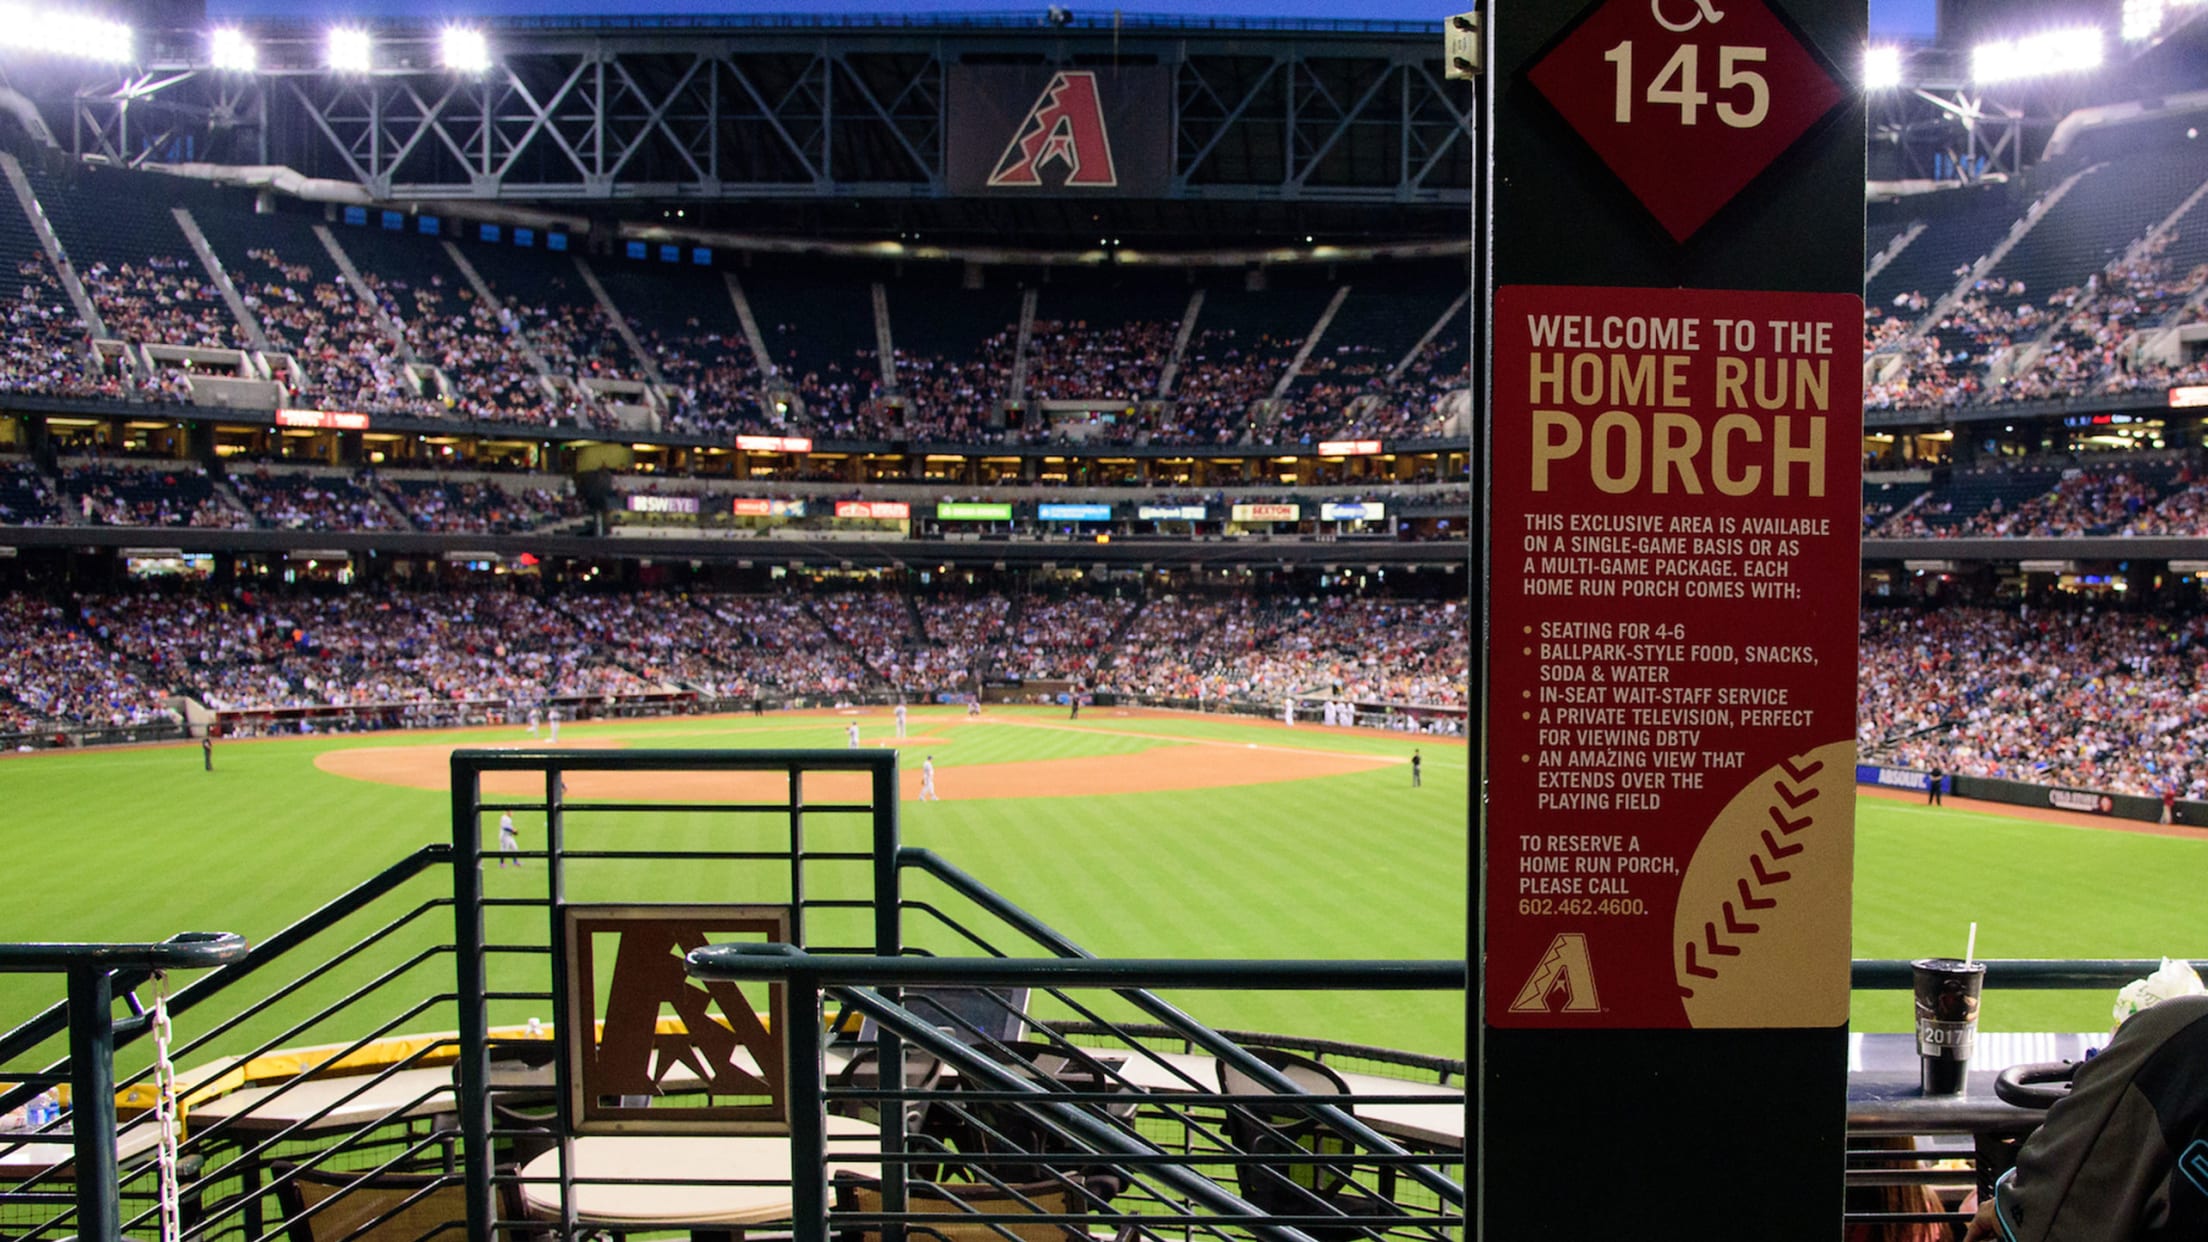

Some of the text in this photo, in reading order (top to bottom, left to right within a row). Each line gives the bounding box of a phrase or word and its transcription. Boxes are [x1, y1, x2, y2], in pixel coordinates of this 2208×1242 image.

[1604, 40, 1770, 128] 145
[1528, 314, 1833, 353] WELCOME TO THE
[1530, 352, 1830, 410] HOME RUN
[1531, 409, 1826, 497] PORCH
[1524, 514, 1830, 535] THIS EXCLUSIVE AREA IS AVAILABLE
[1524, 536, 1800, 556] ON A SINGLE-GAME BASIS OR AS
[1524, 558, 1788, 577] A MULTI-GAME PACKAGE. EACH
[1524, 579, 1801, 599] HOME RUN PORCH COMES WITH:
[1540, 622, 1685, 640] SEATING FOR 4-6
[1540, 644, 1818, 665] BALLPARK-STYLE FOOD, SNACKS,
[1540, 666, 1669, 682] SODA & WATER
[1540, 687, 1788, 705] IN-SEAT WAIT-STAFF SERVICE
[1539, 709, 1813, 728] A PRIVATE TELEVISION, PERFECT
[1539, 730, 1700, 746] FOR VIEWING DBTV
[1538, 751, 1745, 768] AN AMAZING VIEW THAT
[1538, 772, 1703, 789] EXTENDS OVER THE
[1538, 793, 1660, 810] PLAYING FIELD
[1520, 836, 1640, 851] TO RESERVE A
[1520, 857, 1680, 876] HOME RUN PORCH,
[1520, 878, 1629, 894] PLEASE CALL
[1519, 899, 1649, 915] 602.462.4600.
[1925, 1027, 1963, 1044] 2017
